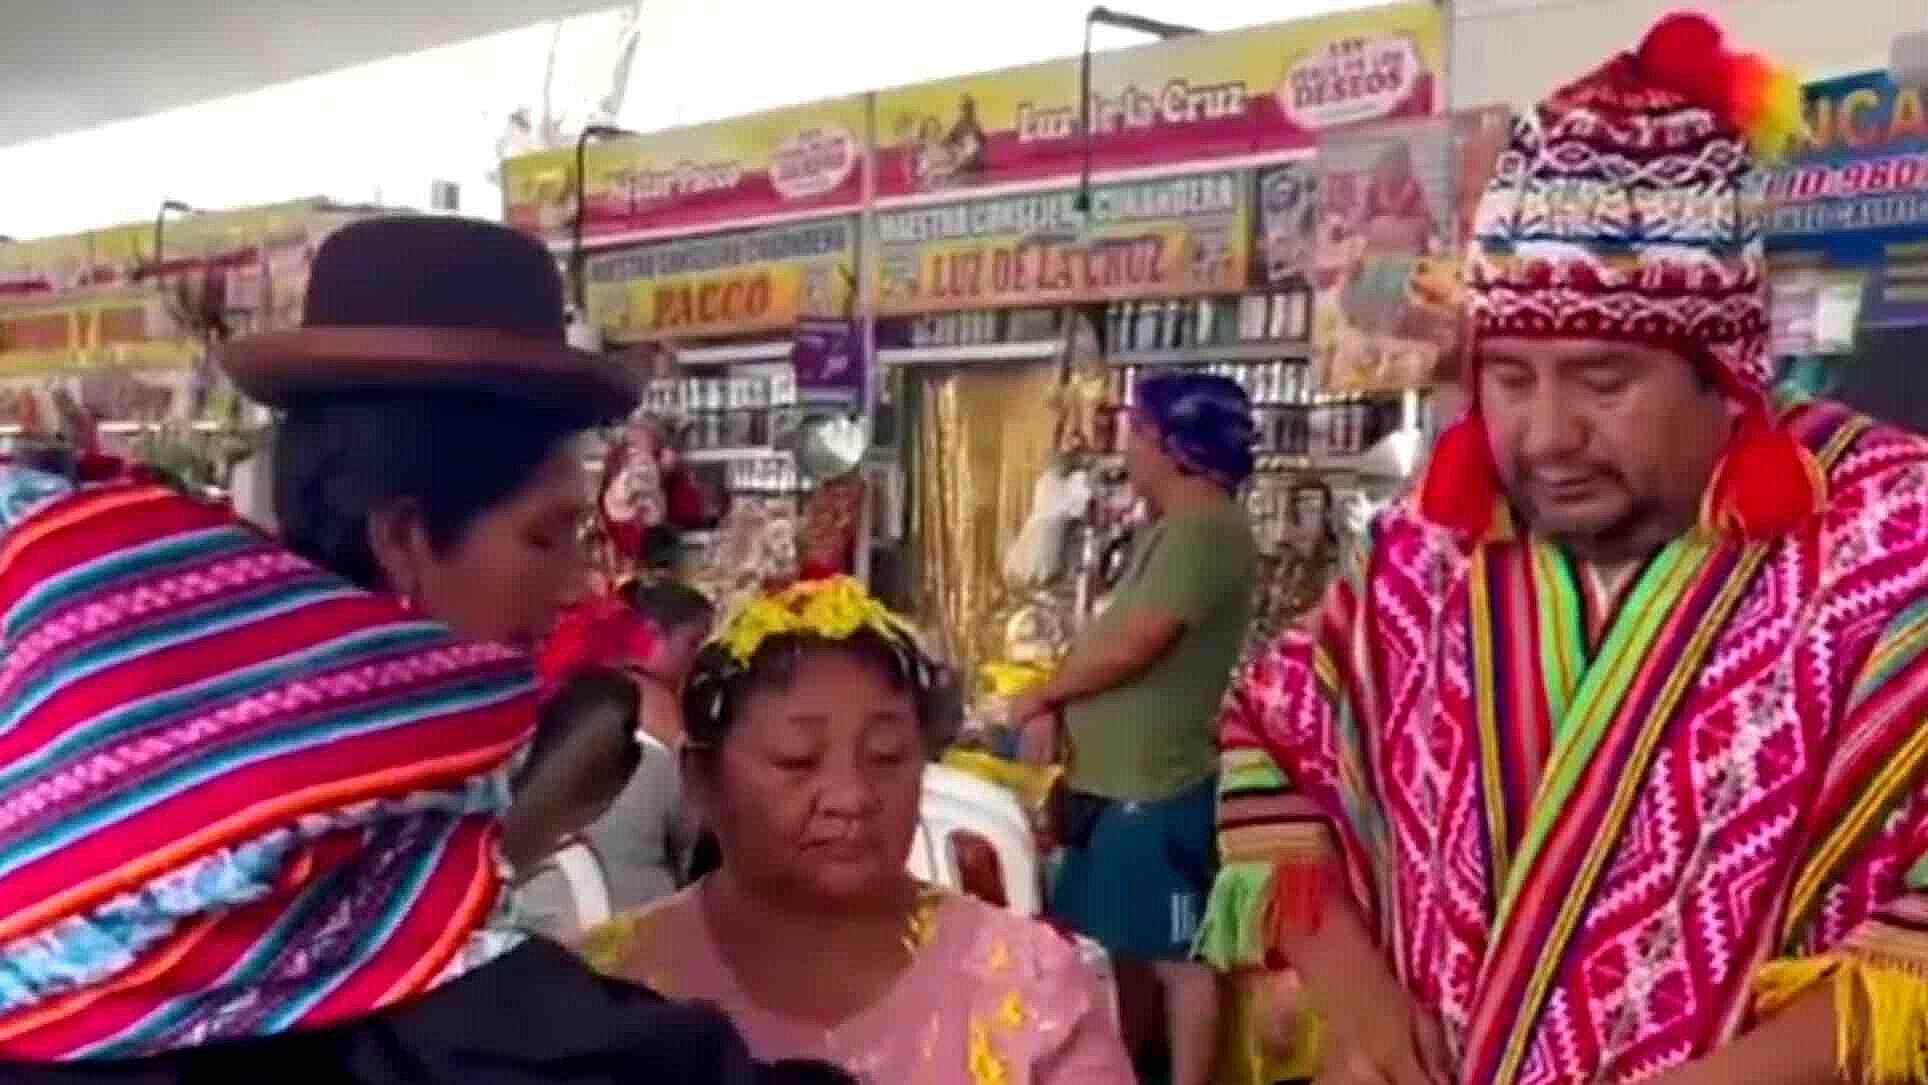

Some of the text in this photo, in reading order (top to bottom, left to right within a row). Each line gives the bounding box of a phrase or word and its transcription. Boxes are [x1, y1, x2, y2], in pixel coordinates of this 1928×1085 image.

[1161, 78, 1246, 122] Cruz
[1294, 68, 1404, 108] DESEOS
[931, 234, 1165, 297] LUZ DE LA CRUZ
[653, 274, 770, 328] PACCO
